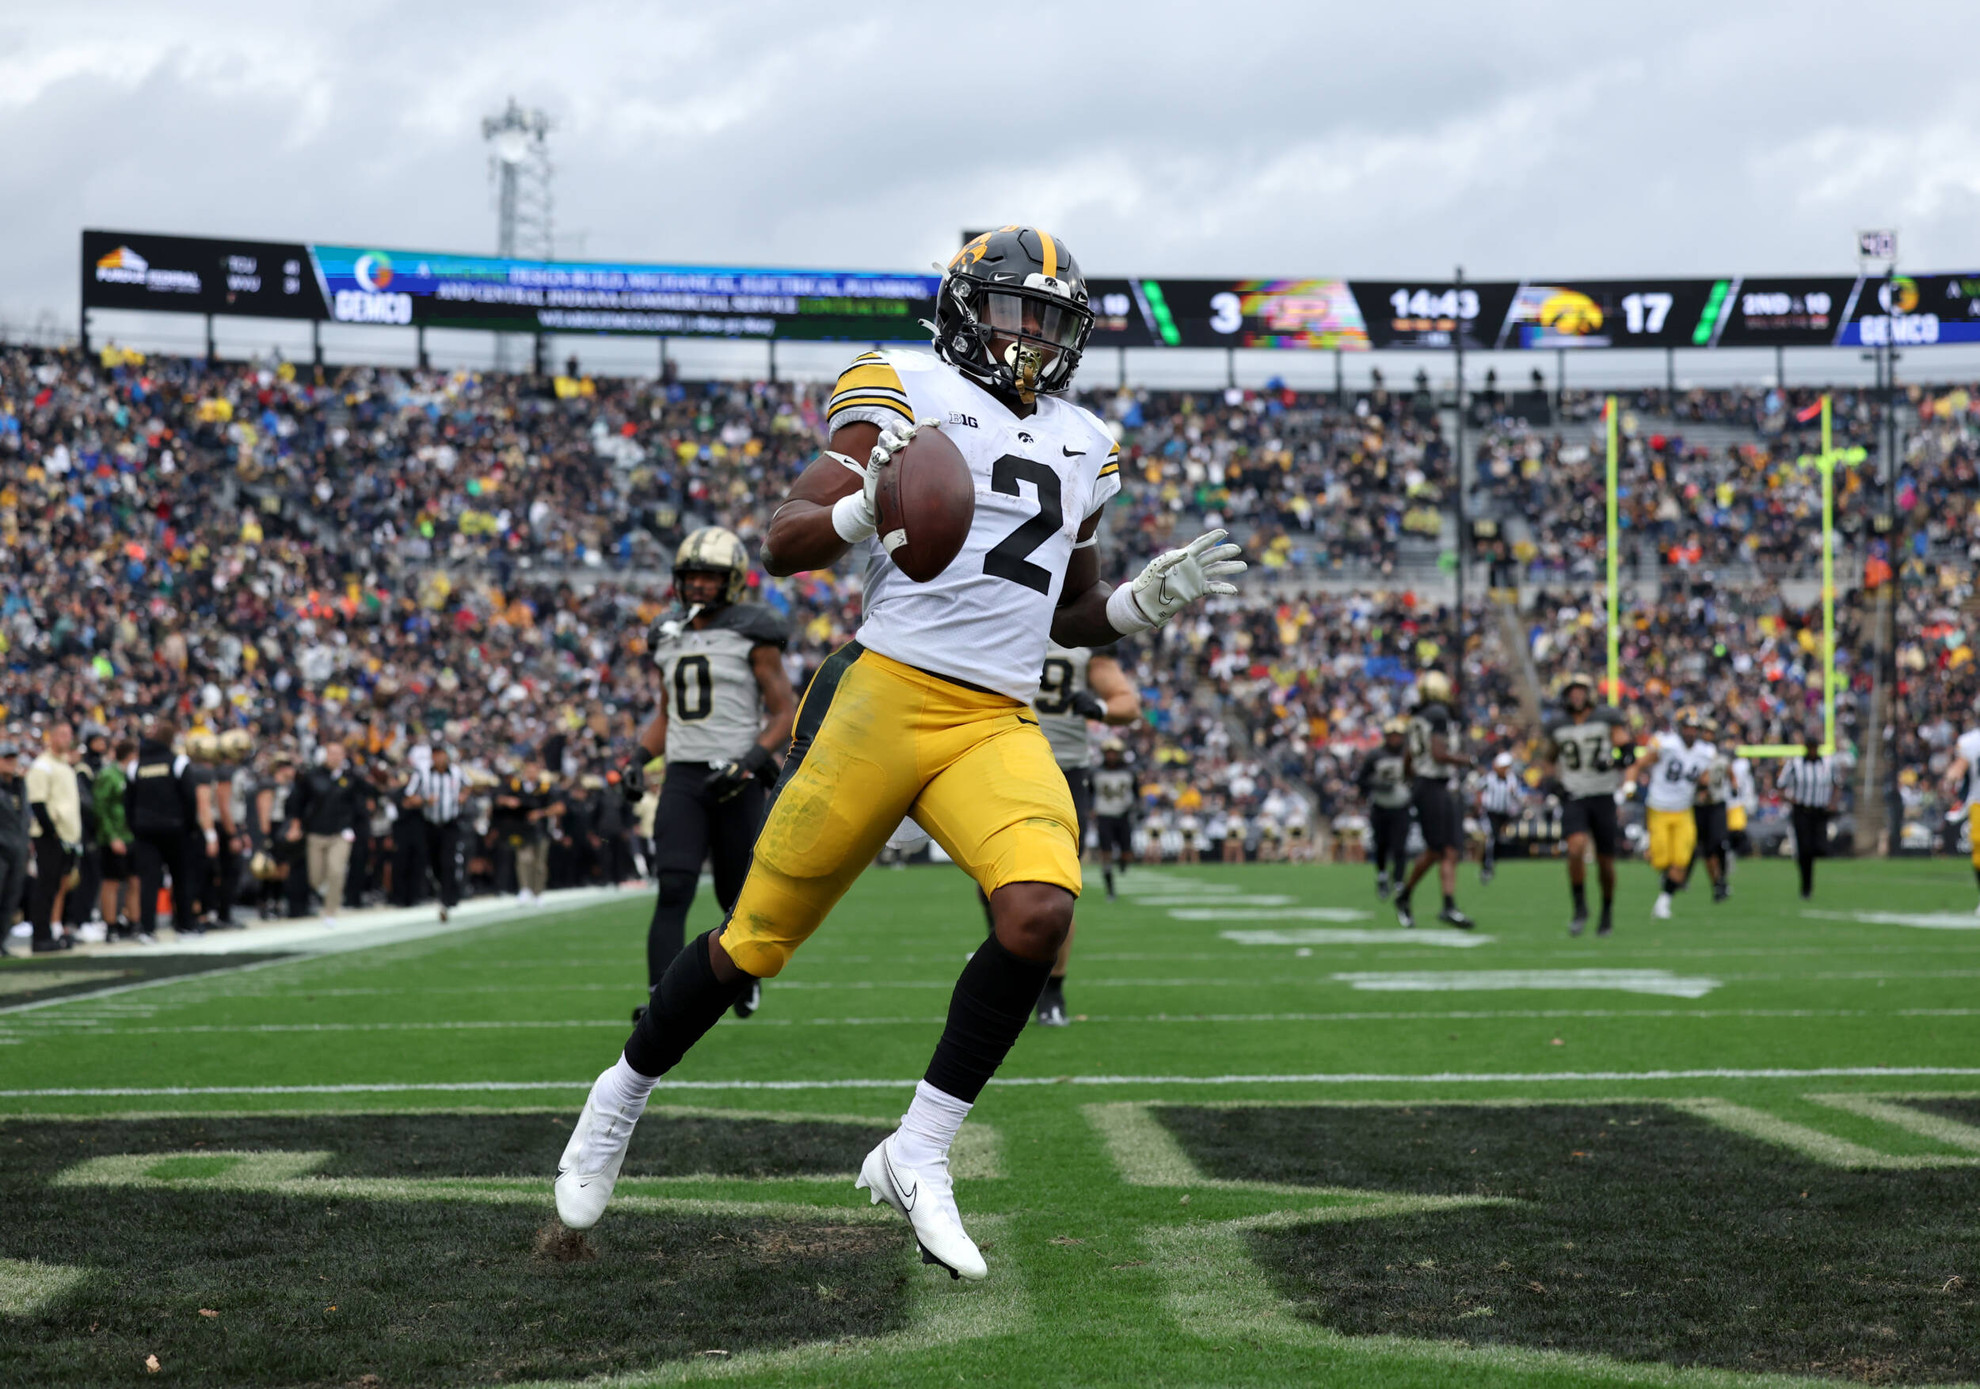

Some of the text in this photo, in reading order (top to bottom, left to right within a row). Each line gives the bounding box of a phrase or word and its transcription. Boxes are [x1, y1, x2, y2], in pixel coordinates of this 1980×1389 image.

[1209, 292, 1243, 335] 3
[1389, 288, 1480, 319] 14:43
[1621, 292, 1674, 333] 17
[1804, 292, 1832, 315] 10
[982, 453, 1064, 596] 2
[675, 654, 713, 722] 0
[1559, 735, 1610, 774] 97
